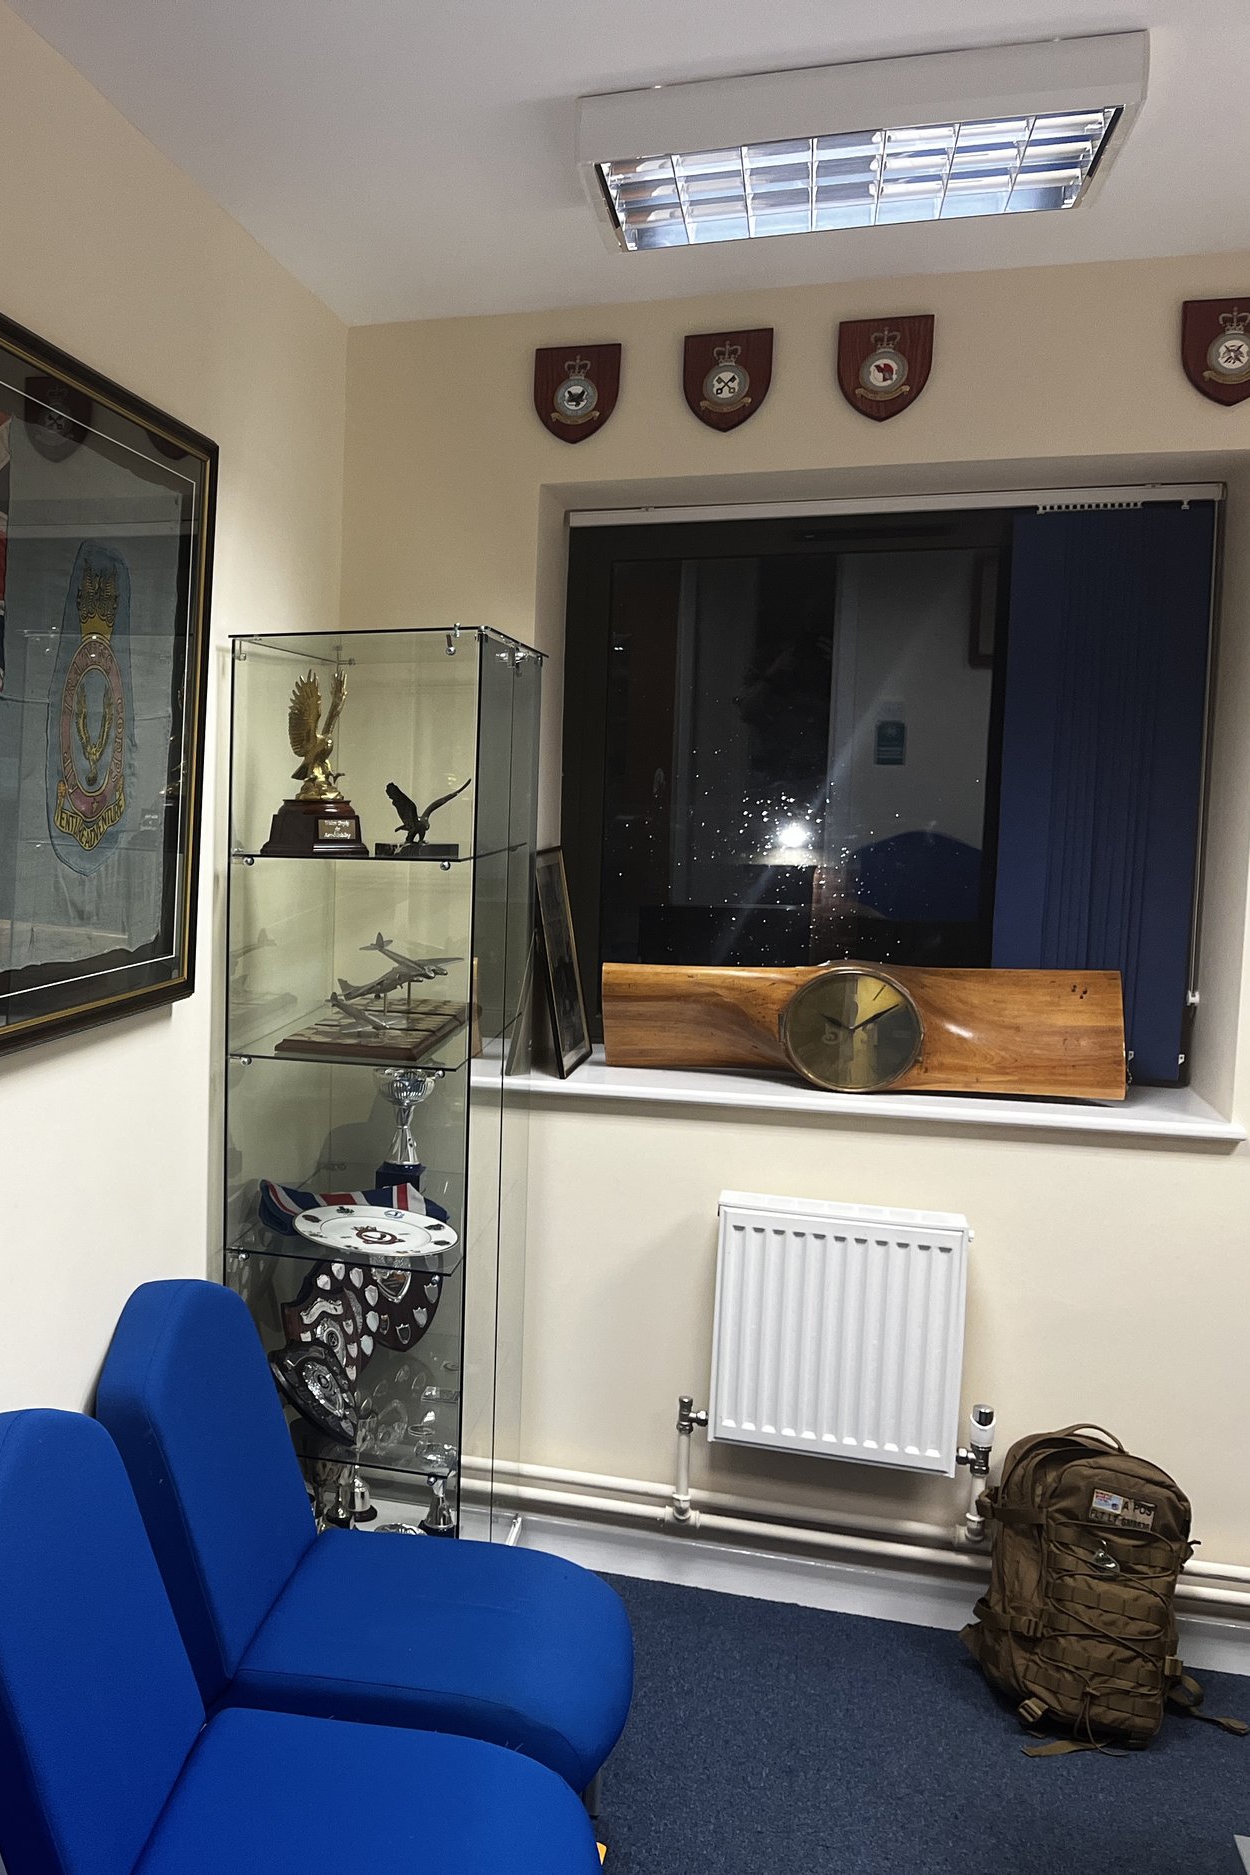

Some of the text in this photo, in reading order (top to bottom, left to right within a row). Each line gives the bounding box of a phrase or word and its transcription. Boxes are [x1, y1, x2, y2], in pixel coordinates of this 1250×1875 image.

[111, 697, 124, 782] CORPS
[85, 801, 124, 848] ADVENTURE
[1122, 1501, 1152, 1516] A POS
